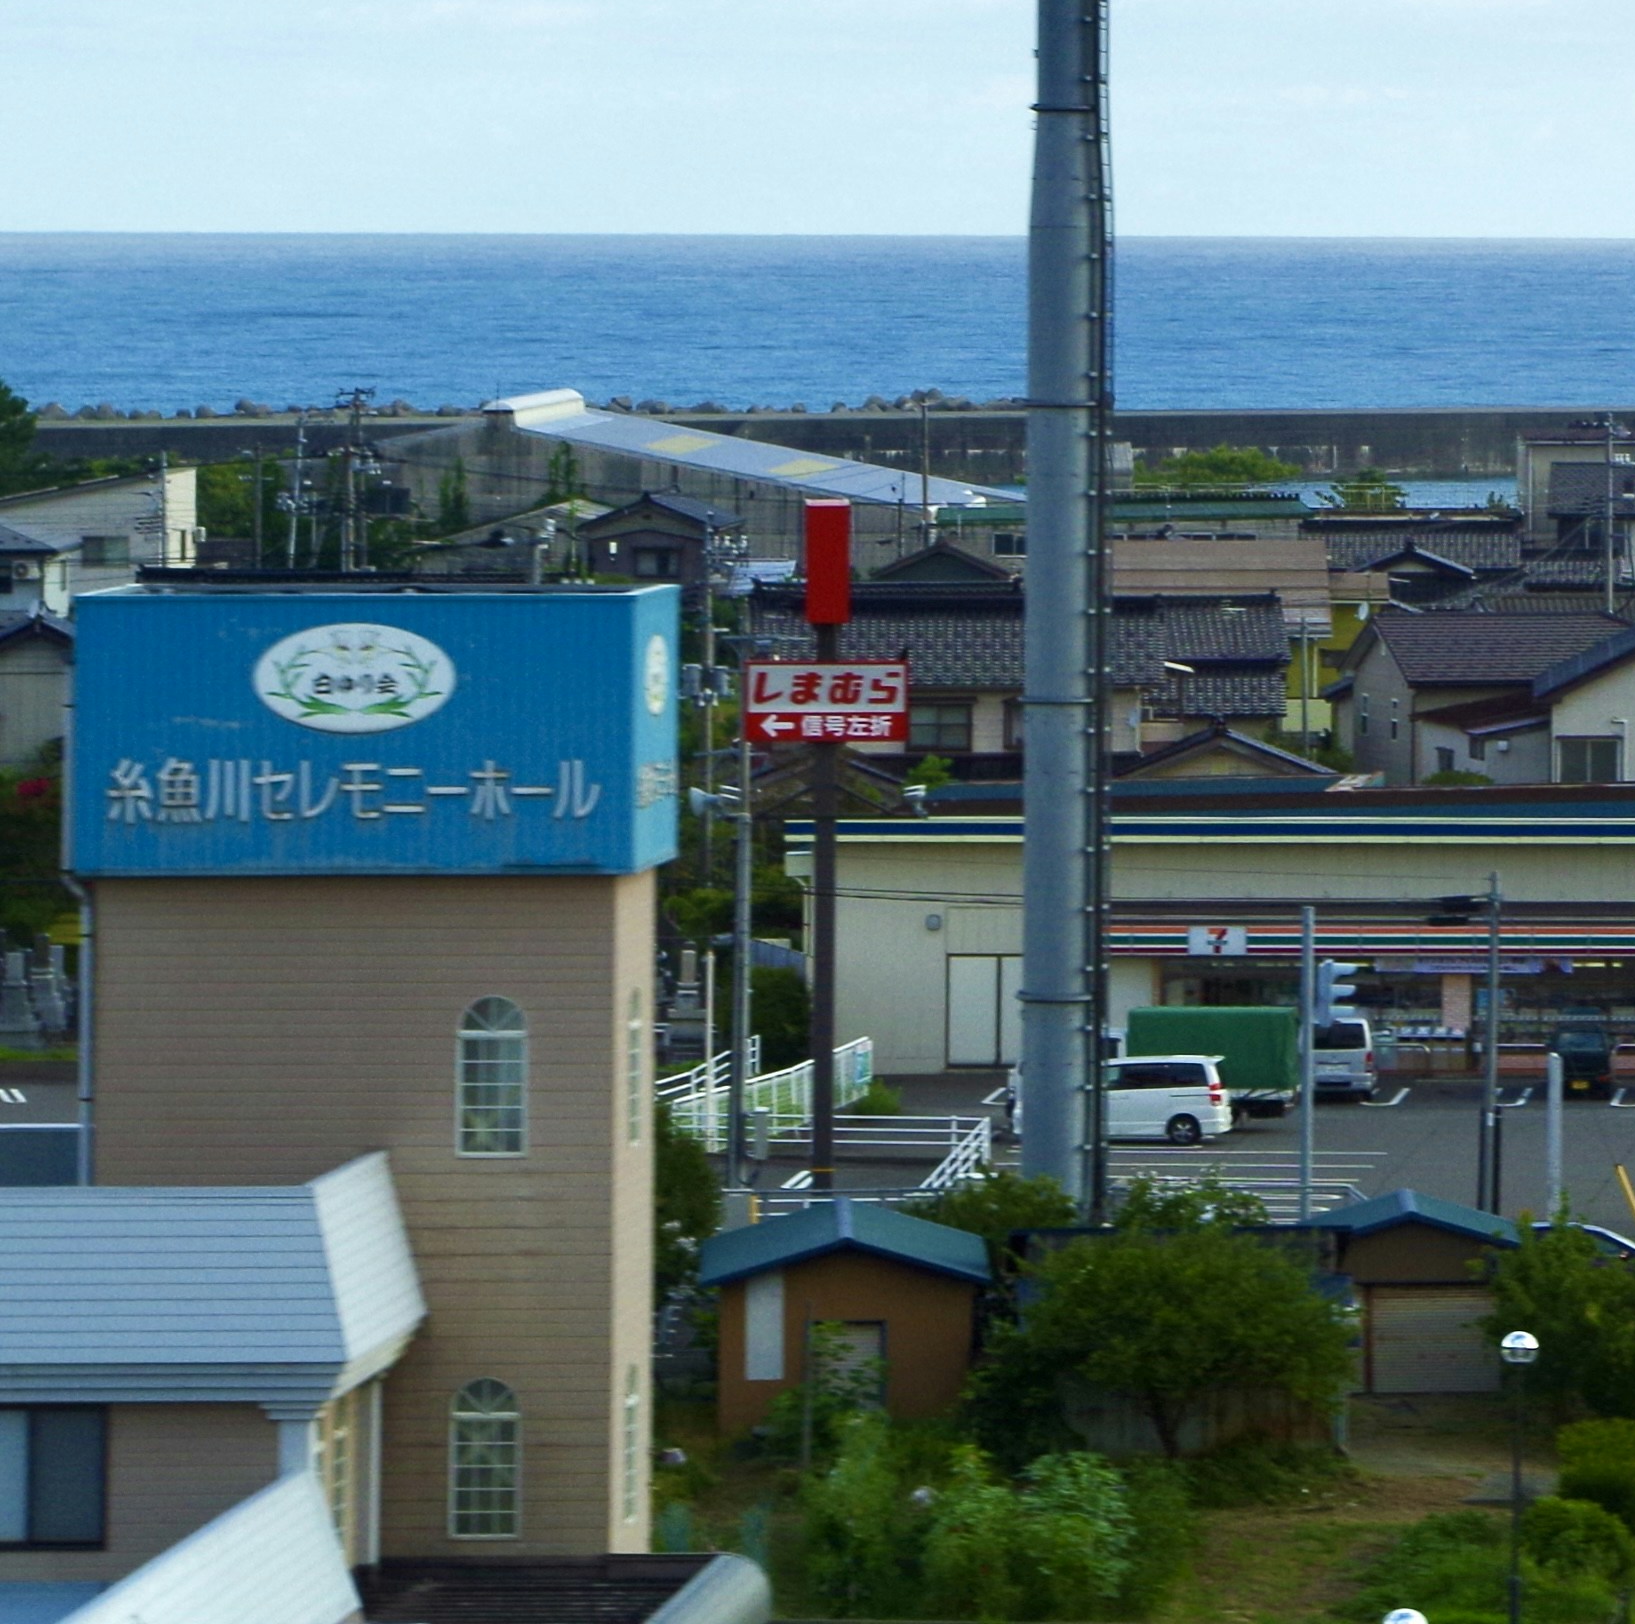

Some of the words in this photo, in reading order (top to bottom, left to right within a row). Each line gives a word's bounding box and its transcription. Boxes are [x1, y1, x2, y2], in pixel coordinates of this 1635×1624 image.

[312, 672, 398, 696] 白ゆり会
[753, 672, 900, 704] しまむら
[802, 715, 892, 737] 信号左折
[106, 758, 601, 823] 糸魚川セレモニーホール
